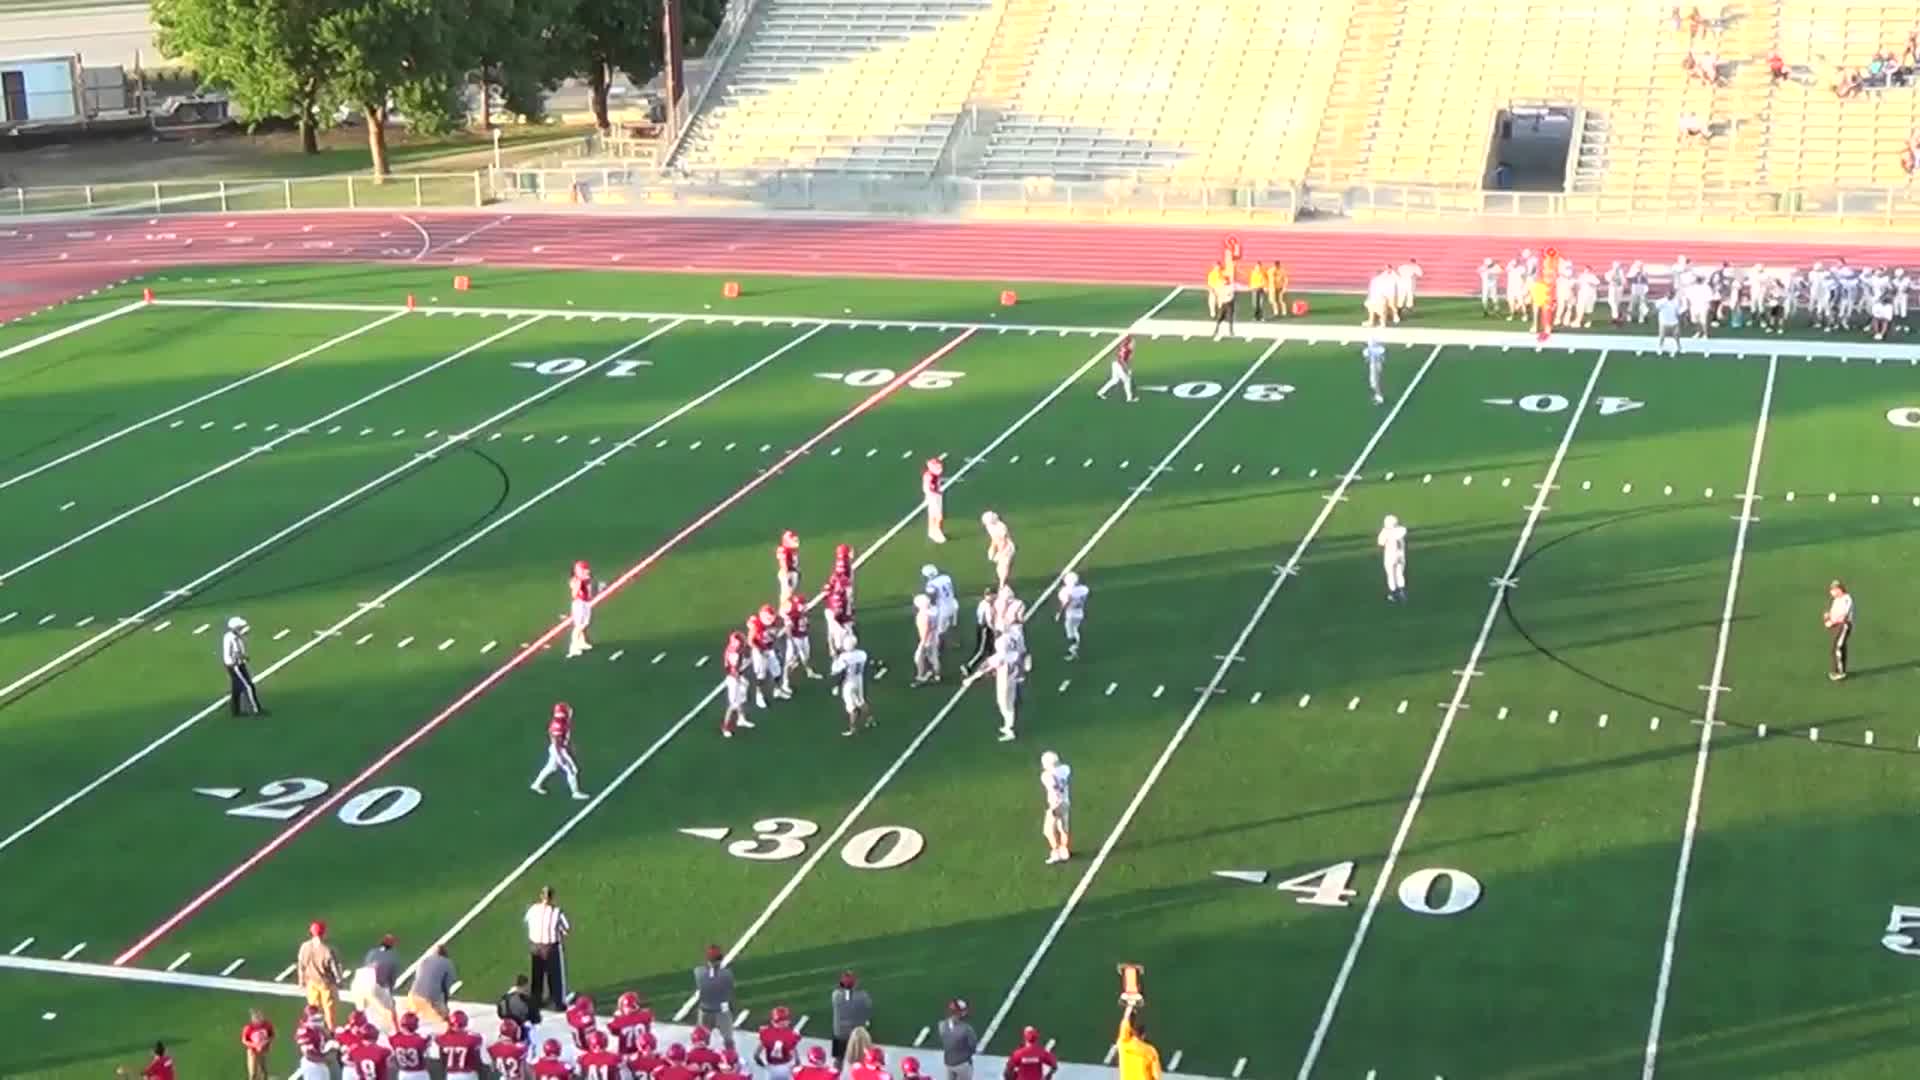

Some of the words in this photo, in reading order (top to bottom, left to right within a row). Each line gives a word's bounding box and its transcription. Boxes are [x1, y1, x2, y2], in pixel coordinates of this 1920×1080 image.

[224, 777, 422, 825] 20
[728, 817, 924, 869] 30
[1277, 861, 1481, 914] 40
[442, 1047, 467, 1068] 77
